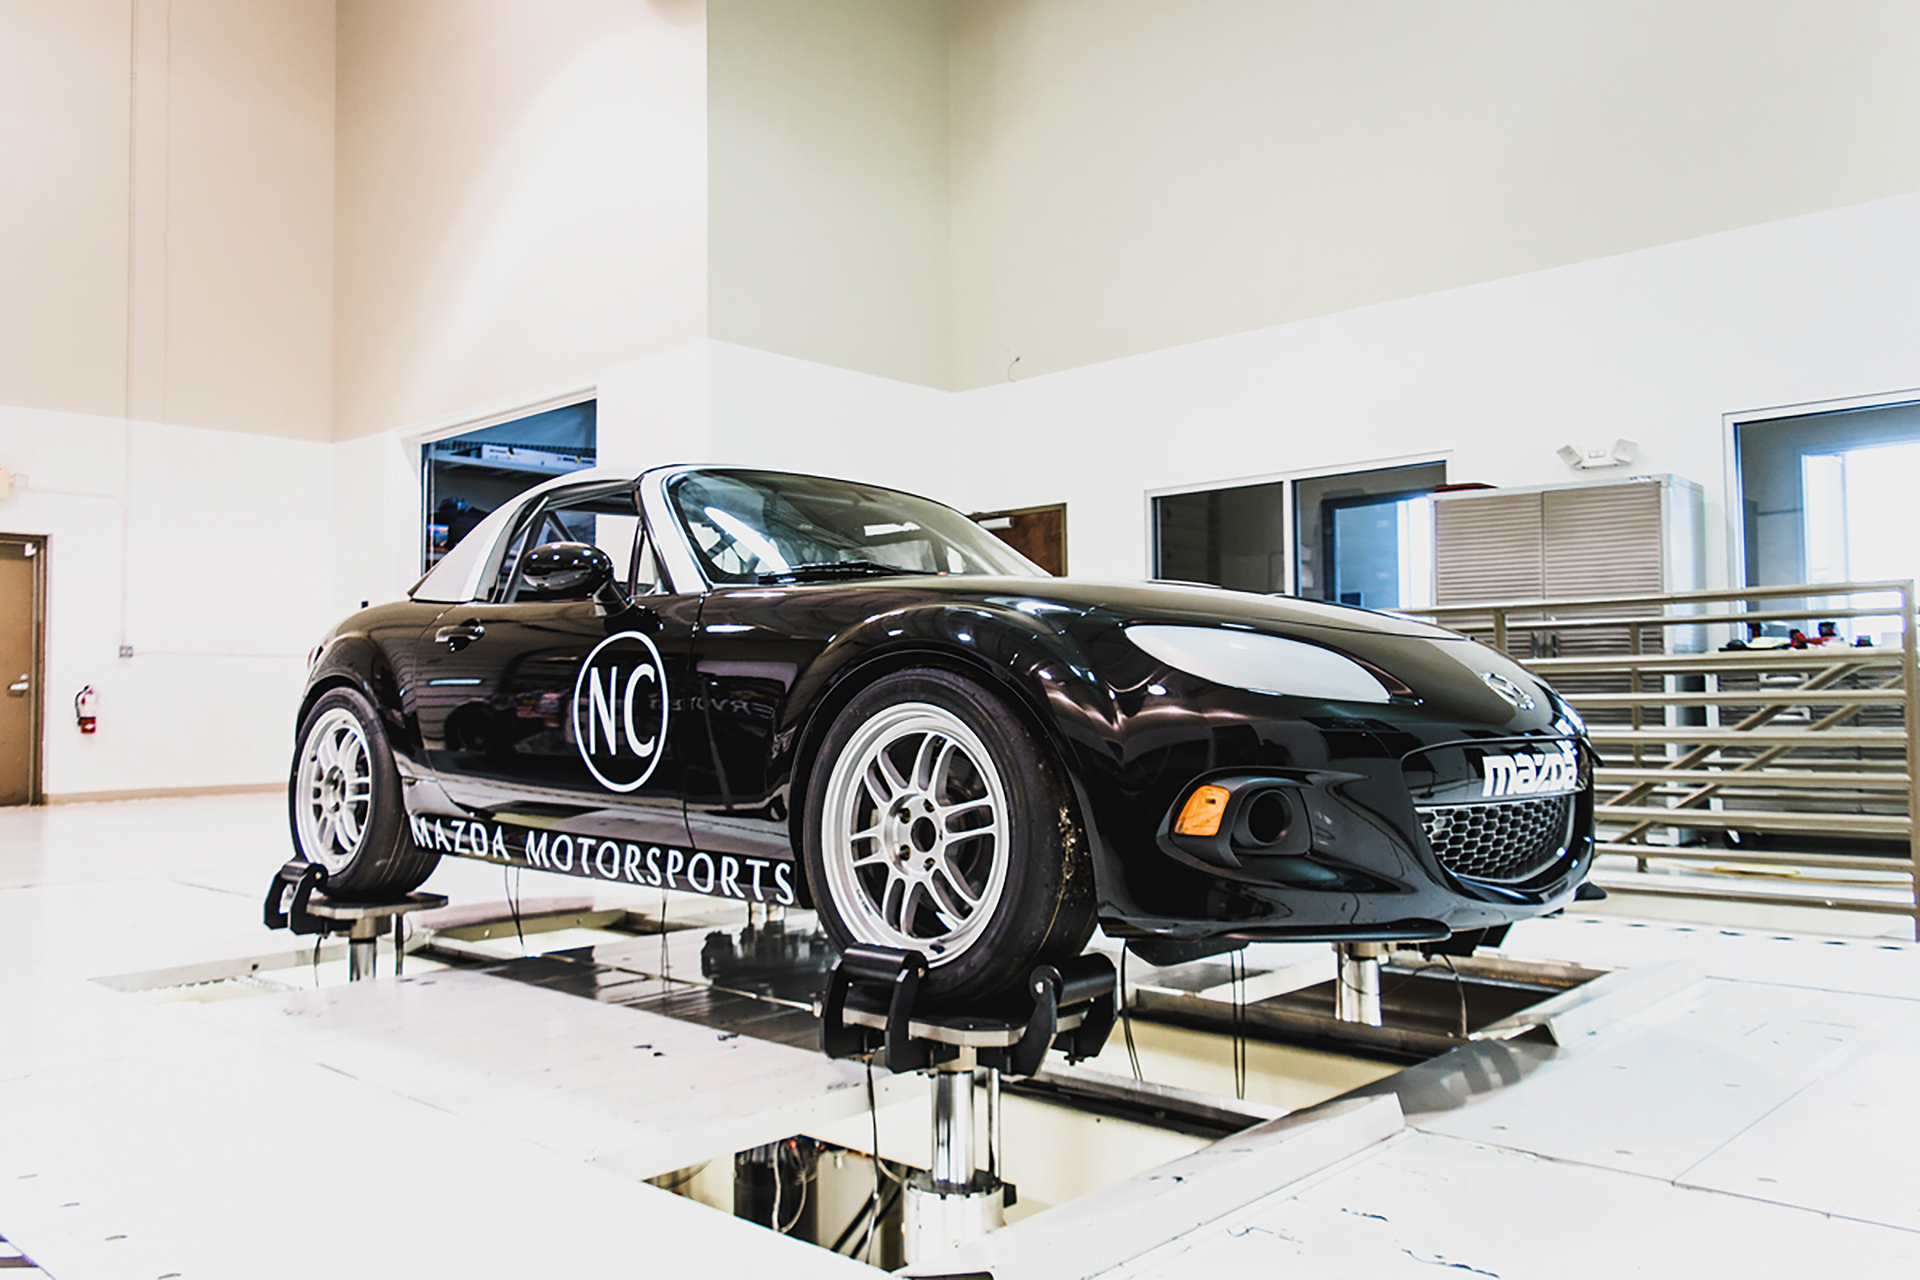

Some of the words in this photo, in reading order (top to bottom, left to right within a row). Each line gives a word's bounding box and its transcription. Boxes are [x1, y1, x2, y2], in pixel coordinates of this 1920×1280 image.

[589, 664, 655, 758] NC
[410, 816, 511, 860] MAZDA
[525, 830, 795, 906] MOTORSPORTS
